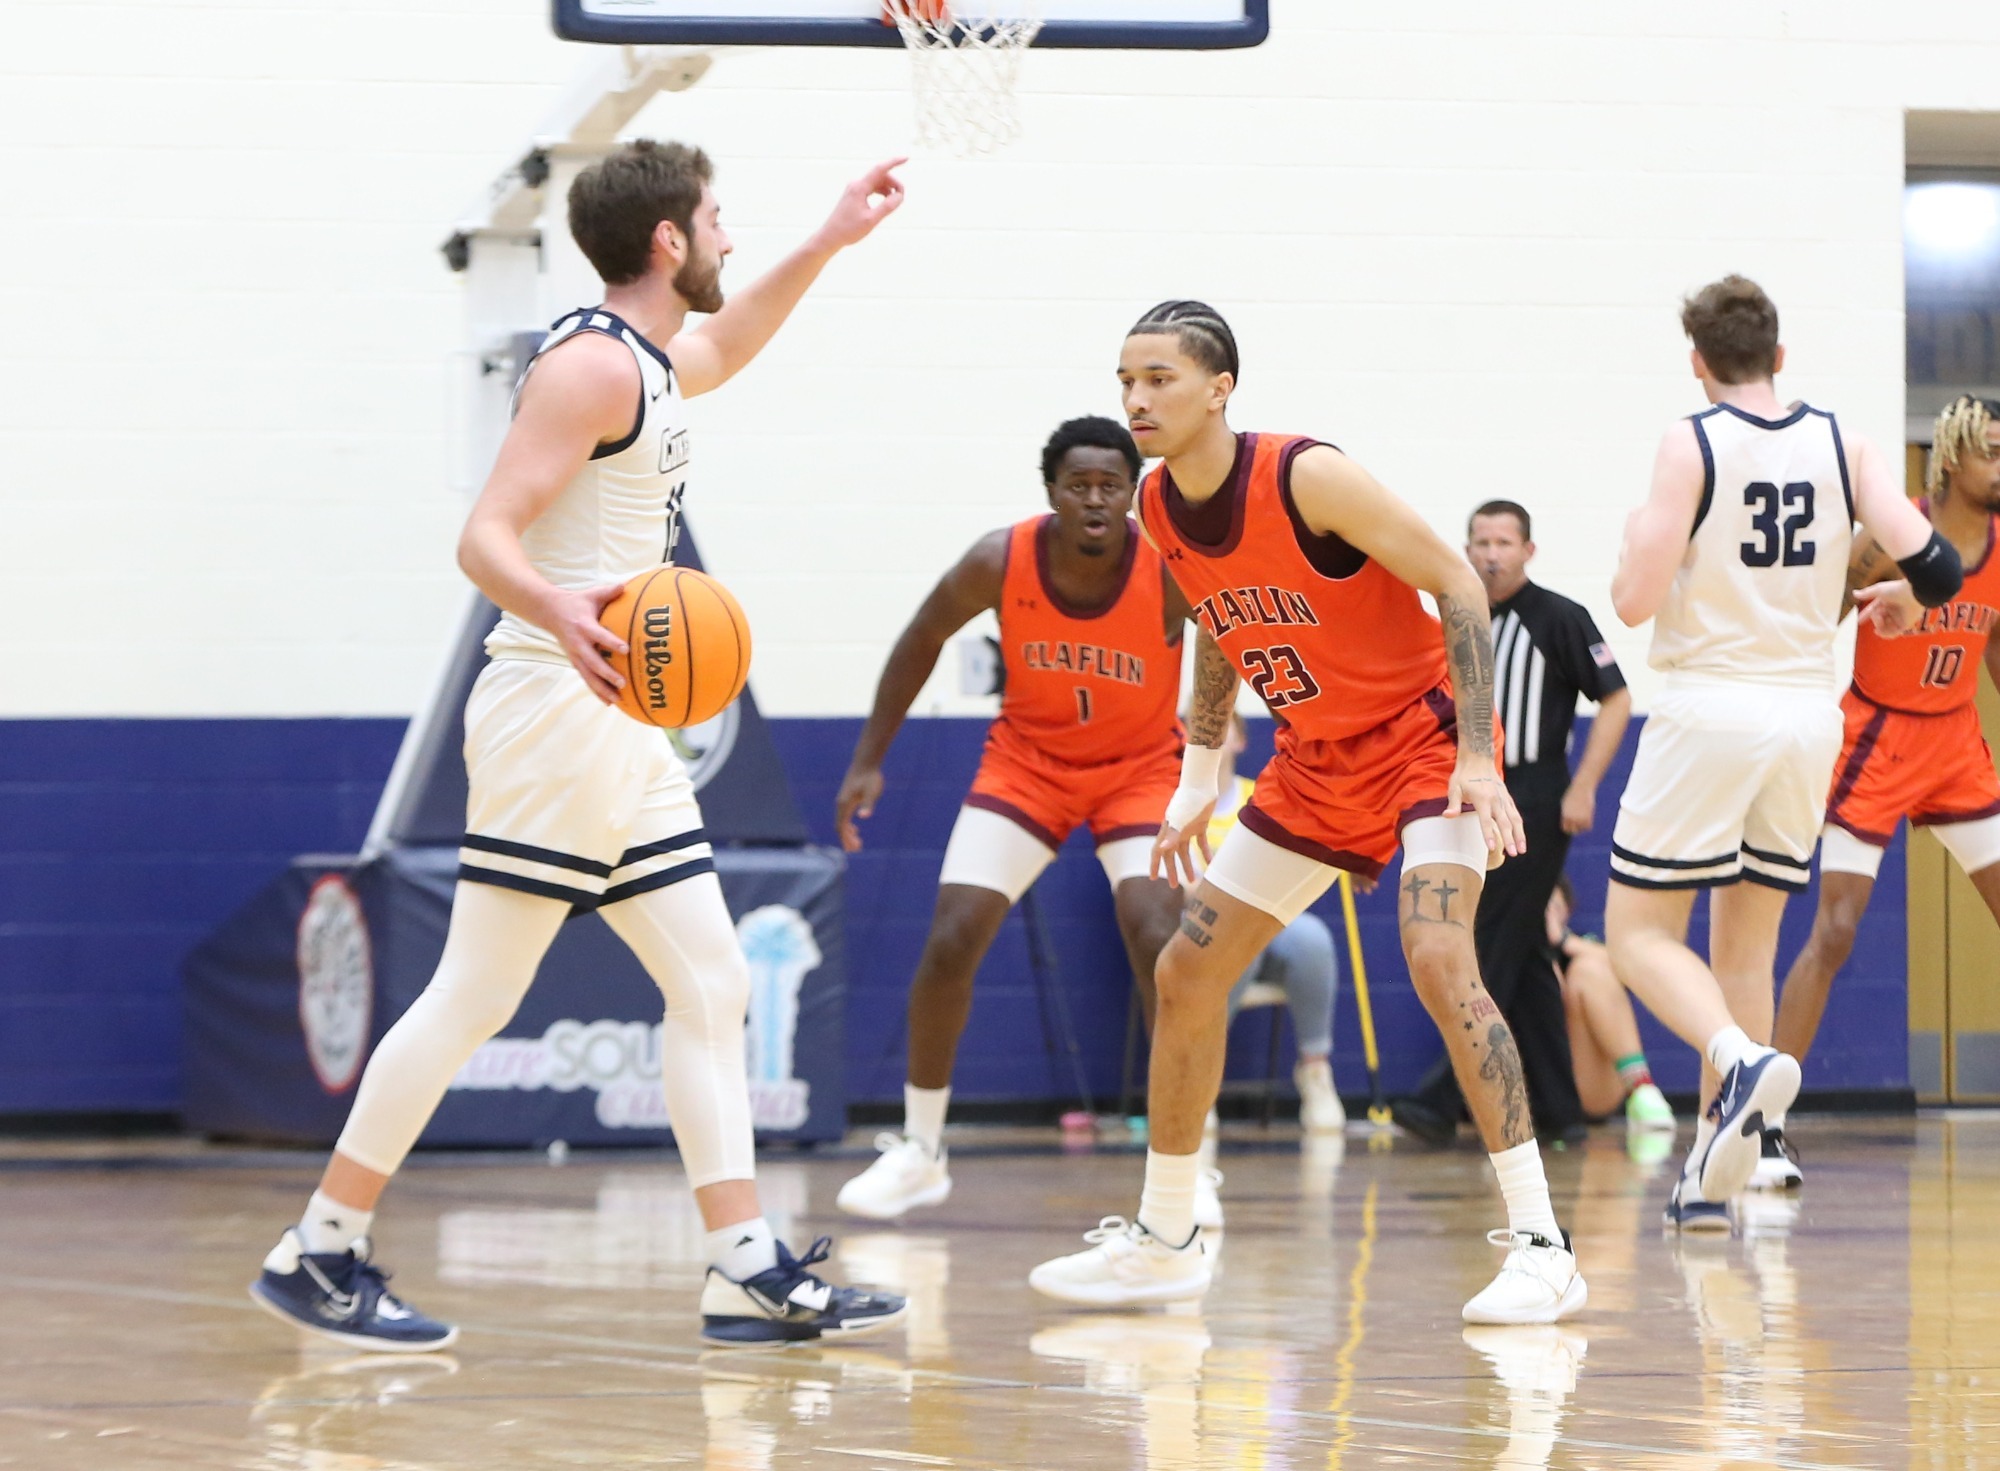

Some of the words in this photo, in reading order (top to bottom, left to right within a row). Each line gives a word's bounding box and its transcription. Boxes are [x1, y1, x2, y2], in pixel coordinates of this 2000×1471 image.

[1740, 481, 1815, 567] 32
[1193, 586, 1320, 640] LAFLIN
[643, 604, 672, 710] Wilson
[1022, 640, 1145, 688] CLAFLIN
[1242, 644, 1321, 709] 23
[1920, 644, 1966, 689] 10
[1073, 686, 1093, 725] 1
[552, 1030, 667, 1080] SOU
